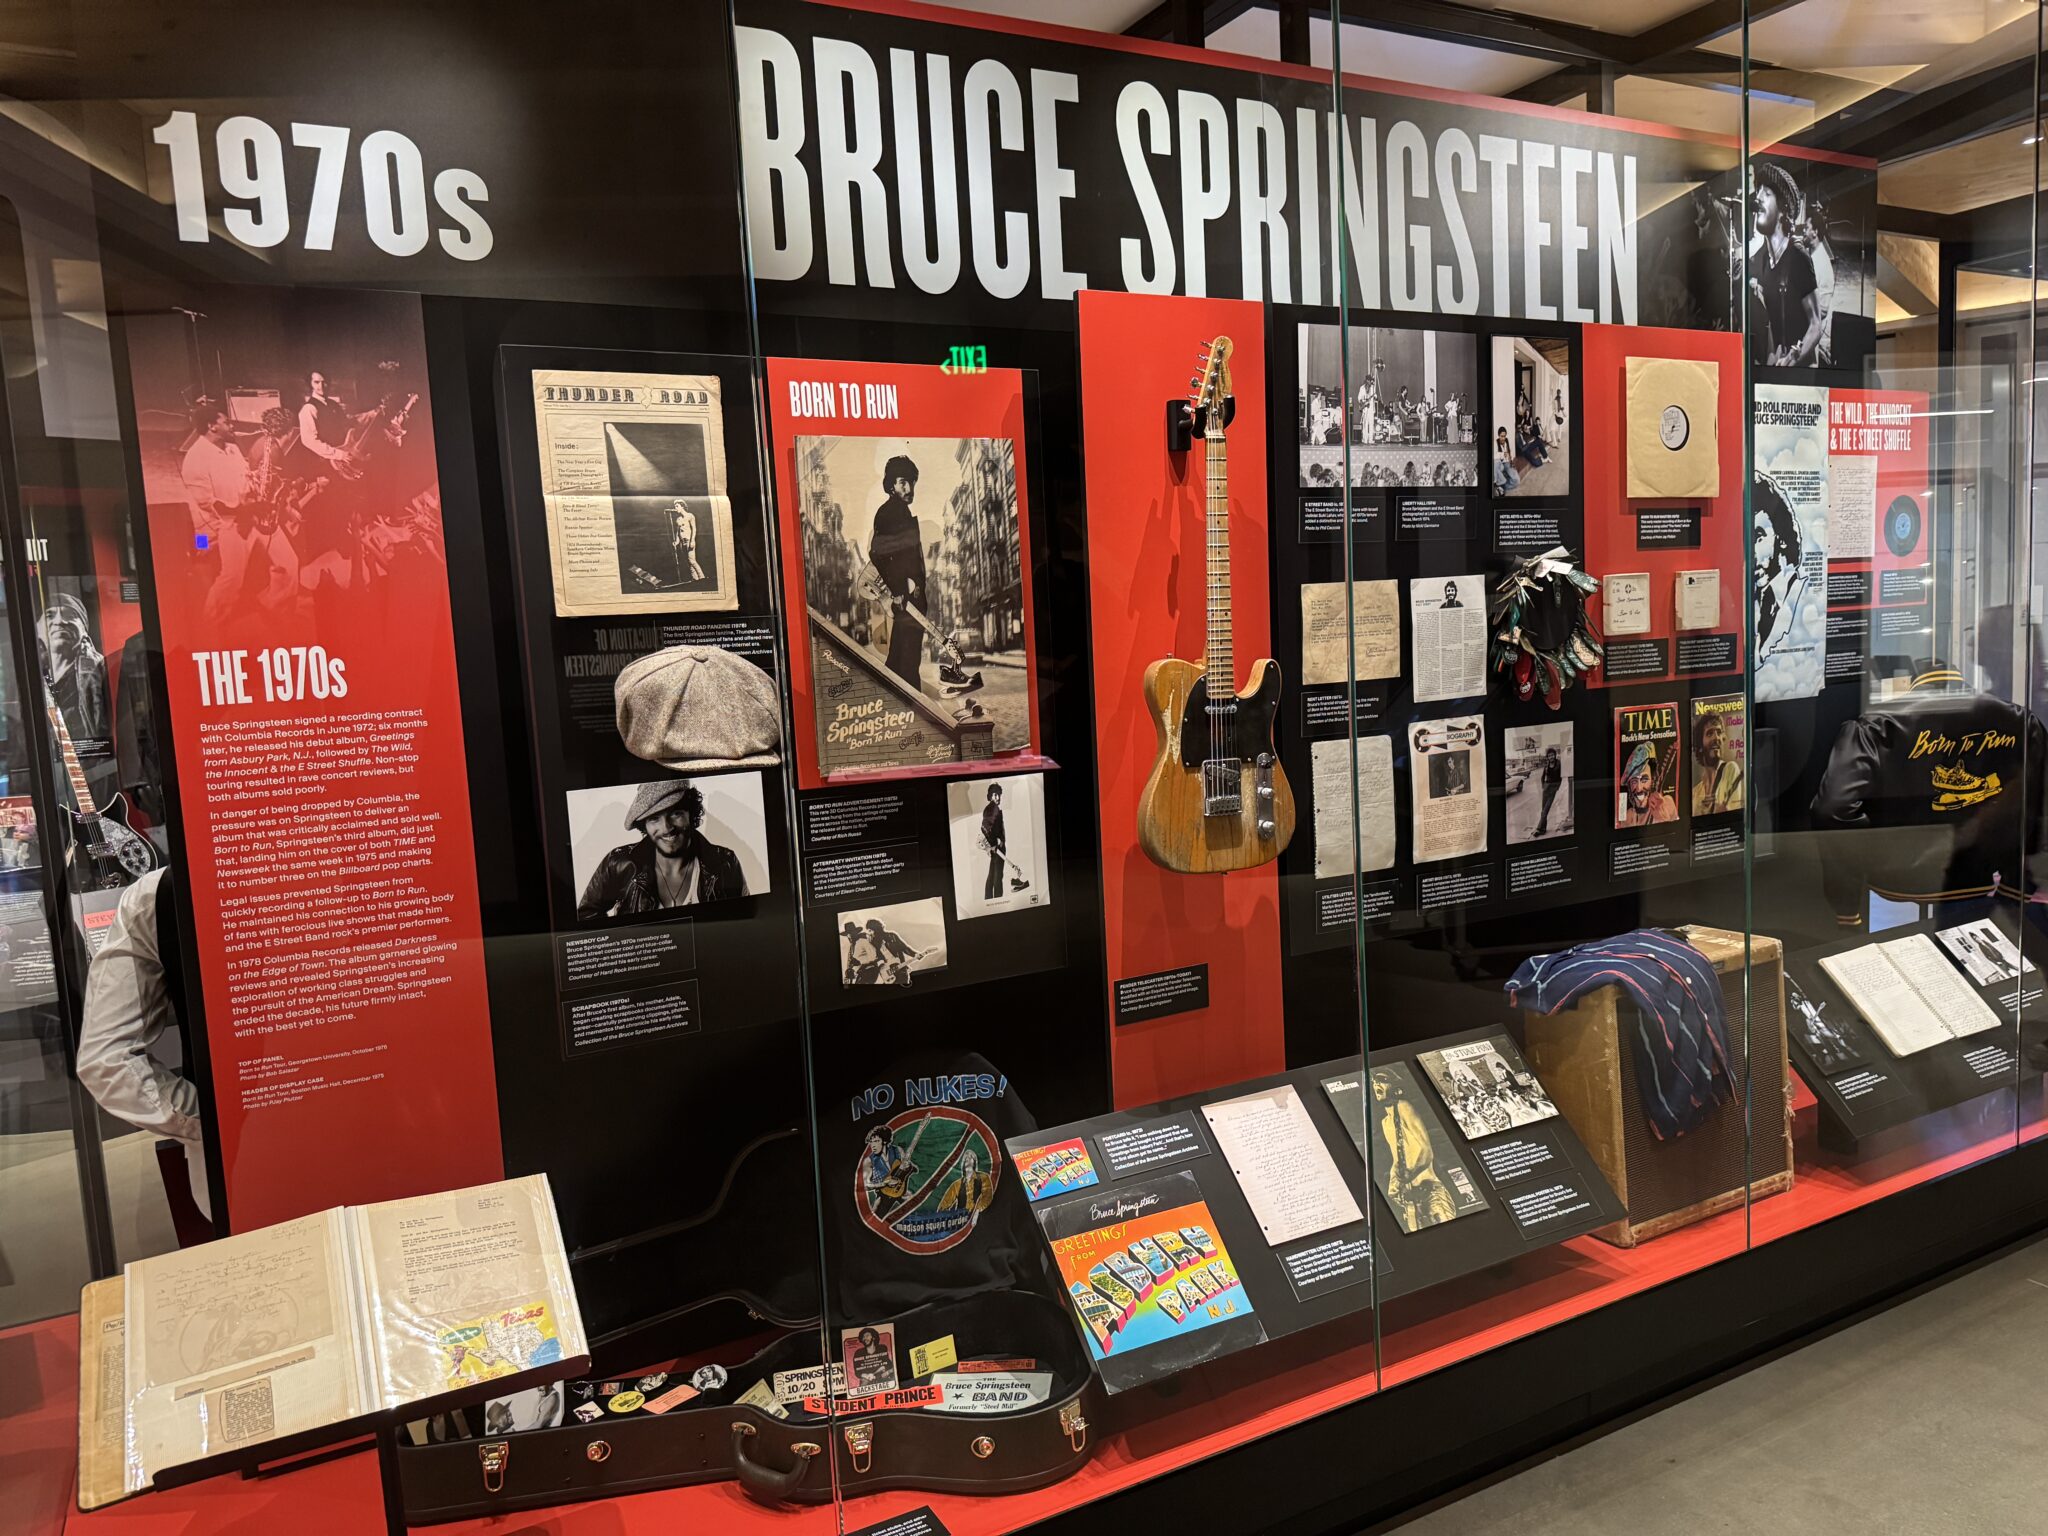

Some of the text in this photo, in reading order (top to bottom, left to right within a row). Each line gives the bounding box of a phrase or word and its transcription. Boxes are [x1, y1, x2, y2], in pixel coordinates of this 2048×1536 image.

[152, 110, 494, 261] 1970s
[735, 25, 1637, 325] BRUCE SPRINGSTEEN
[544, 386, 709, 404] THUNDER ROAD
[789, 381, 899, 420] BORN TO RUN
[1763, 402, 1780, 413] ROLL
[1781, 402, 1807, 414] FUTURE
[1808, 403, 1822, 415] AND
[1831, 402, 1912, 426] THE WILD, THE INNOCENT
[1830, 428, 1911, 451] & THE E STREET SHUFFLE
[192, 645, 348, 706] THE 1970s
[200, 723, 230, 731] Bruce
[232, 719, 292, 730] Springsteen
[294, 715, 326, 725] signed
[337, 712, 382, 721] recording
[384, 709, 422, 718] contract
[836, 699, 883, 722] Bruce
[1624, 708, 1673, 731] TIME
[201, 734, 222, 743] with
[224, 731, 272, 741] Columbia
[274, 728, 314, 737] Records
[352, 723, 376, 731] 1972;
[393, 720, 427, 728] months
[827, 711, 914, 743] Springsteen
[847, 725, 907, 750] "Born To Run"
[1447, 732, 1474, 740] BIOGRAPHY
[1621, 730, 1676, 743] Rock's New Sensation
[202, 747, 227, 755] later,
[244, 741, 287, 751] released
[289, 740, 303, 748] his
[306, 738, 333, 746] debut
[336, 736, 367, 744] album,
[370, 732, 414, 741] Greetings
[229, 756, 264, 764] Asbury
[266, 752, 290, 761] Park,
[293, 751, 313, 759] N.J.,
[316, 747, 355, 757] followed
[358, 747, 368, 755] by
[391, 742, 412, 750] Wild,
[1908, 730, 2016, 759] Born To Run
[206, 770, 222, 778] the
[224, 766, 267, 776] Innocent
[280, 764, 295, 772] the
[298, 762, 304, 770] E
[306, 760, 336, 769] Street
[338, 758, 373, 767] Shuffle.
[375, 754, 418, 763] Non-stop
[206, 781, 242, 790] touring
[245, 776, 284, 786] resulted
[321, 770, 357, 780] concert
[359, 768, 396, 776] reviews,
[208, 784, 326, 802] both albums sold poorly.
[566, 938, 595, 946] NEWSBOY
[241, 1087, 268, 1095] HEADER
[279, 1080, 305, 1088] DISPLAY
[852, 1074, 1008, 1121] NO NUKES!
[1089, 1194, 1159, 1220] Bruce Springsteen
[897, 1222, 924, 1233] madison
[925, 1221, 946, 1232] square
[1053, 1224, 1127, 1255] GREETINGS
[1070, 1251, 1096, 1270] FROM
[1069, 1225, 1218, 1357] ASBURY
[1156, 1259, 1240, 1325] PARK
[500, 1307, 544, 1328] Texas
[788, 1382, 815, 1394] 10/20
[857, 1382, 890, 1393] BACKSTAGE
[885, 1387, 936, 1404] PRINCE
[945, 1381, 1032, 1391] Bruce Springsteen
[972, 1392, 1028, 1401] BAND
[948, 1403, 977, 1411] Formerly
